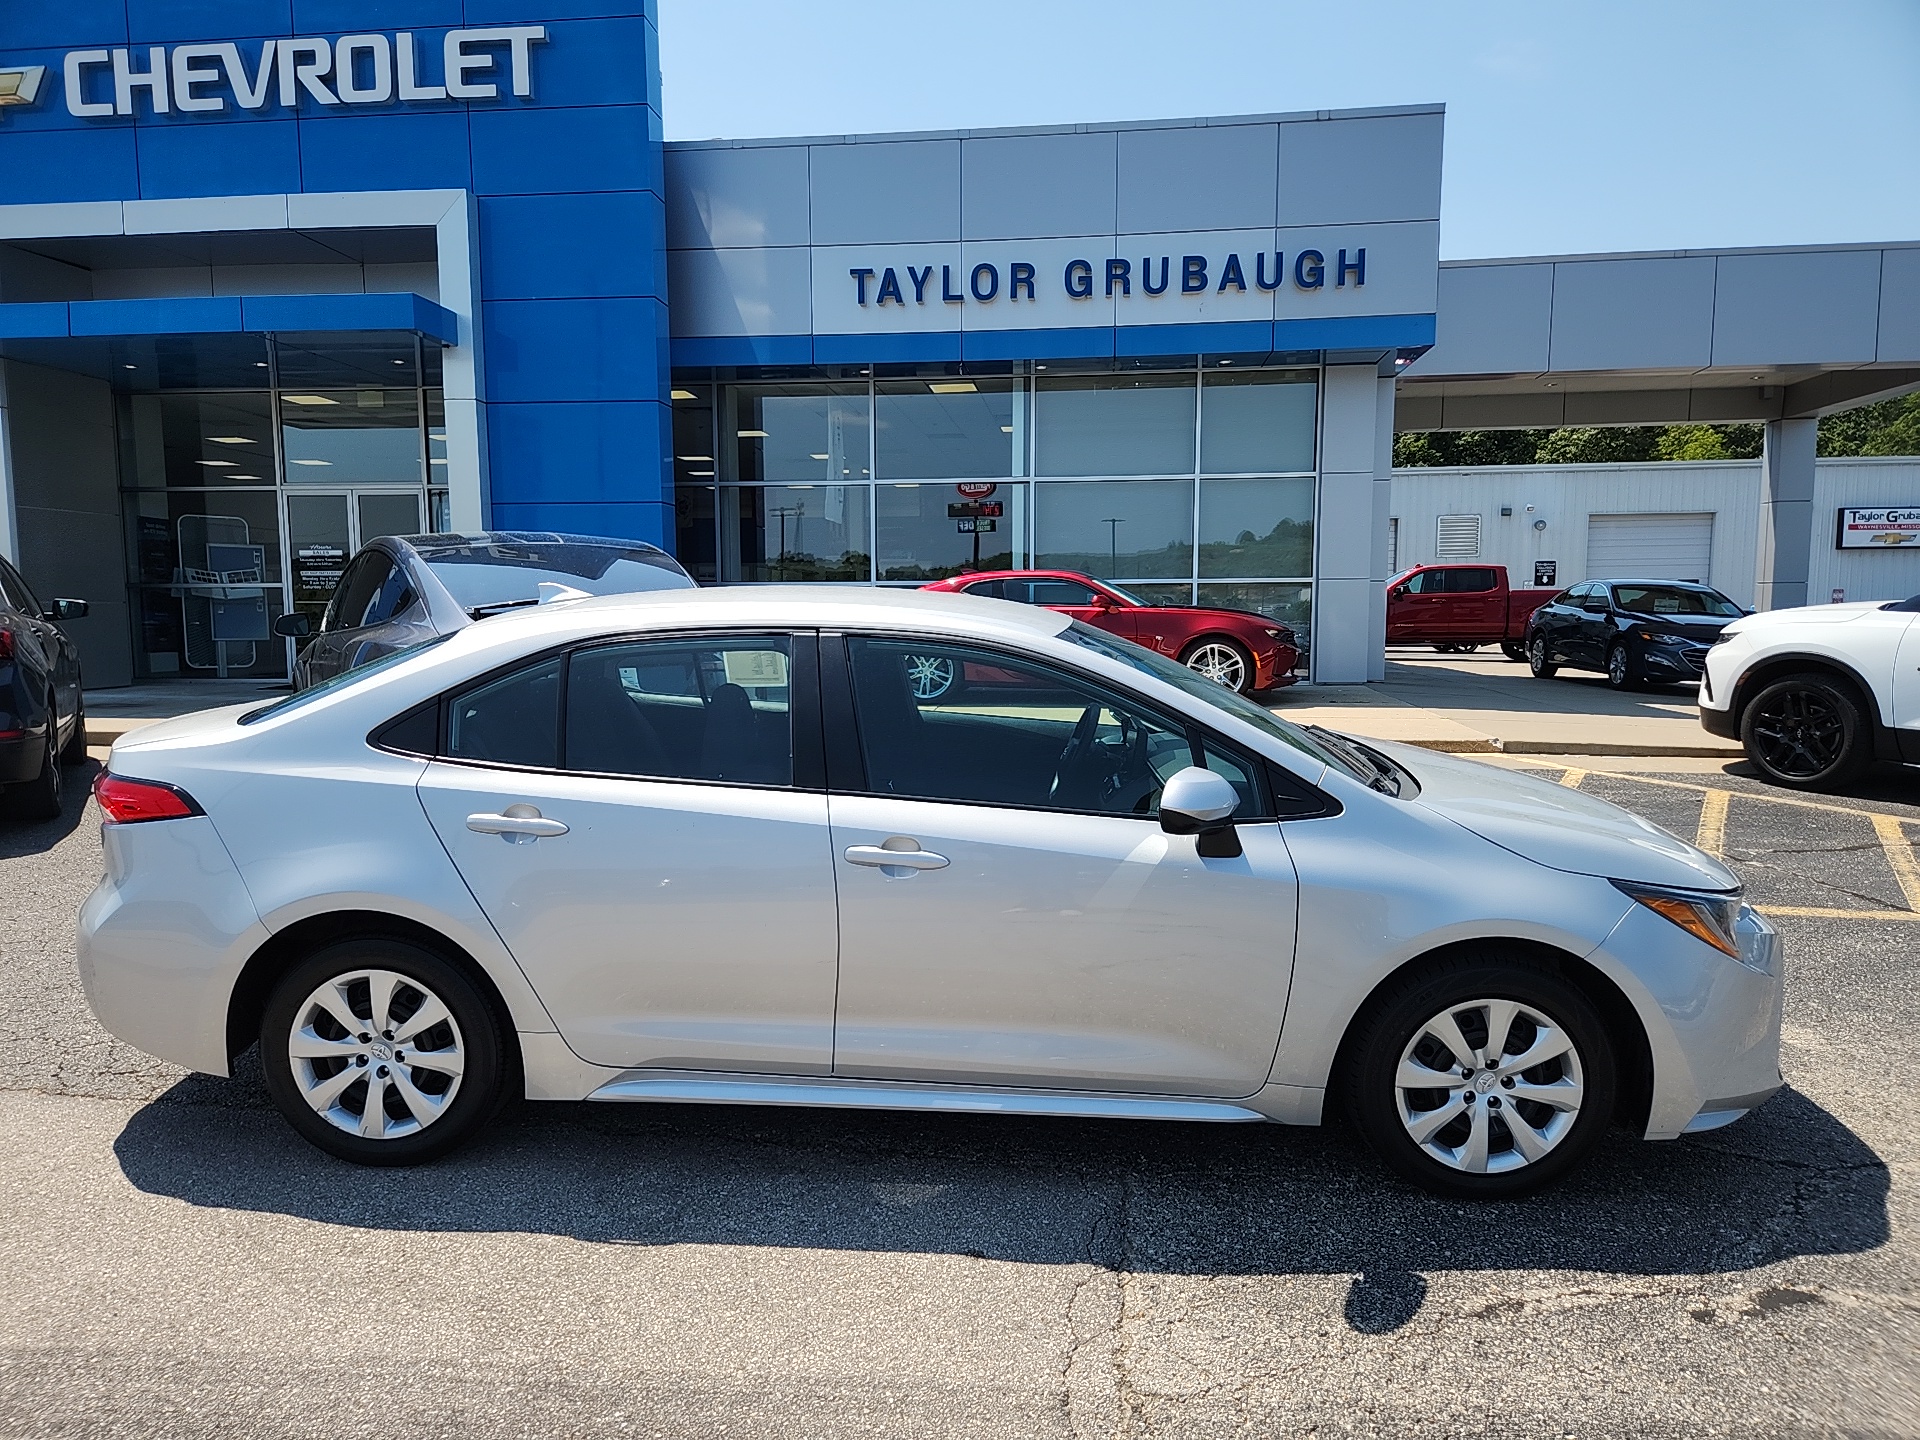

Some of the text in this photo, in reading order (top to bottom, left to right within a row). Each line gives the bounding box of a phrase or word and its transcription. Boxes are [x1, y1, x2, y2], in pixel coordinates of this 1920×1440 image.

[64, 26, 547, 116] CHEVROLET
[849, 247, 1368, 306] TAYLOR GRUBAUGH
[1849, 510, 1885, 523] Taylor
